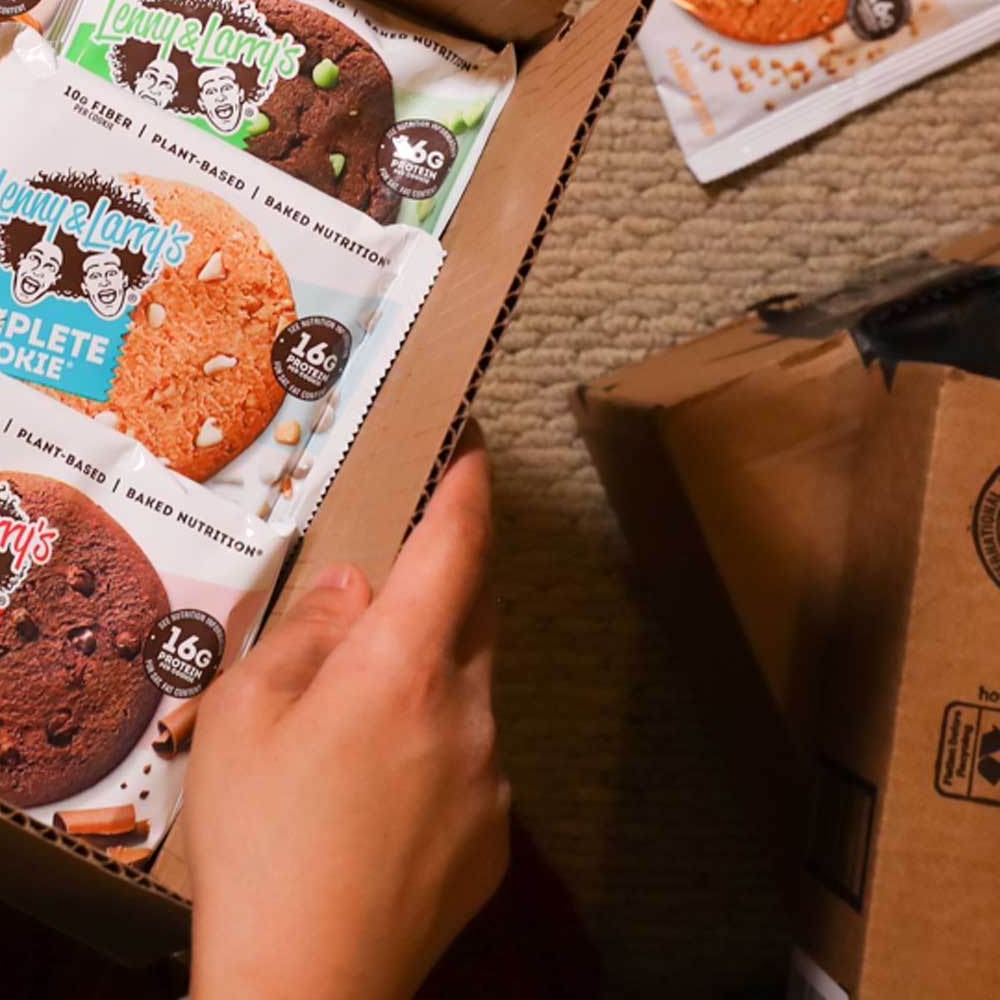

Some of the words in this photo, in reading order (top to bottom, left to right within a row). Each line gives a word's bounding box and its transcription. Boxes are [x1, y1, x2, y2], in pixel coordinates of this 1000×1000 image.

[91, 100, 134, 130] FIBER
[150, 133, 247, 191] PLANT-BASED
[263, 195, 311, 227] BAKED
[390, 158, 438, 181] PROTEIN
[286, 354, 330, 382] PROTEIN
[291, 331, 338, 372] 16G
[16, 427, 108, 485] PLANT-BASED
[125, 487, 174, 518] BAKED
[157, 650, 204, 680] PROTEIN
[161, 625, 213, 669] 16G
